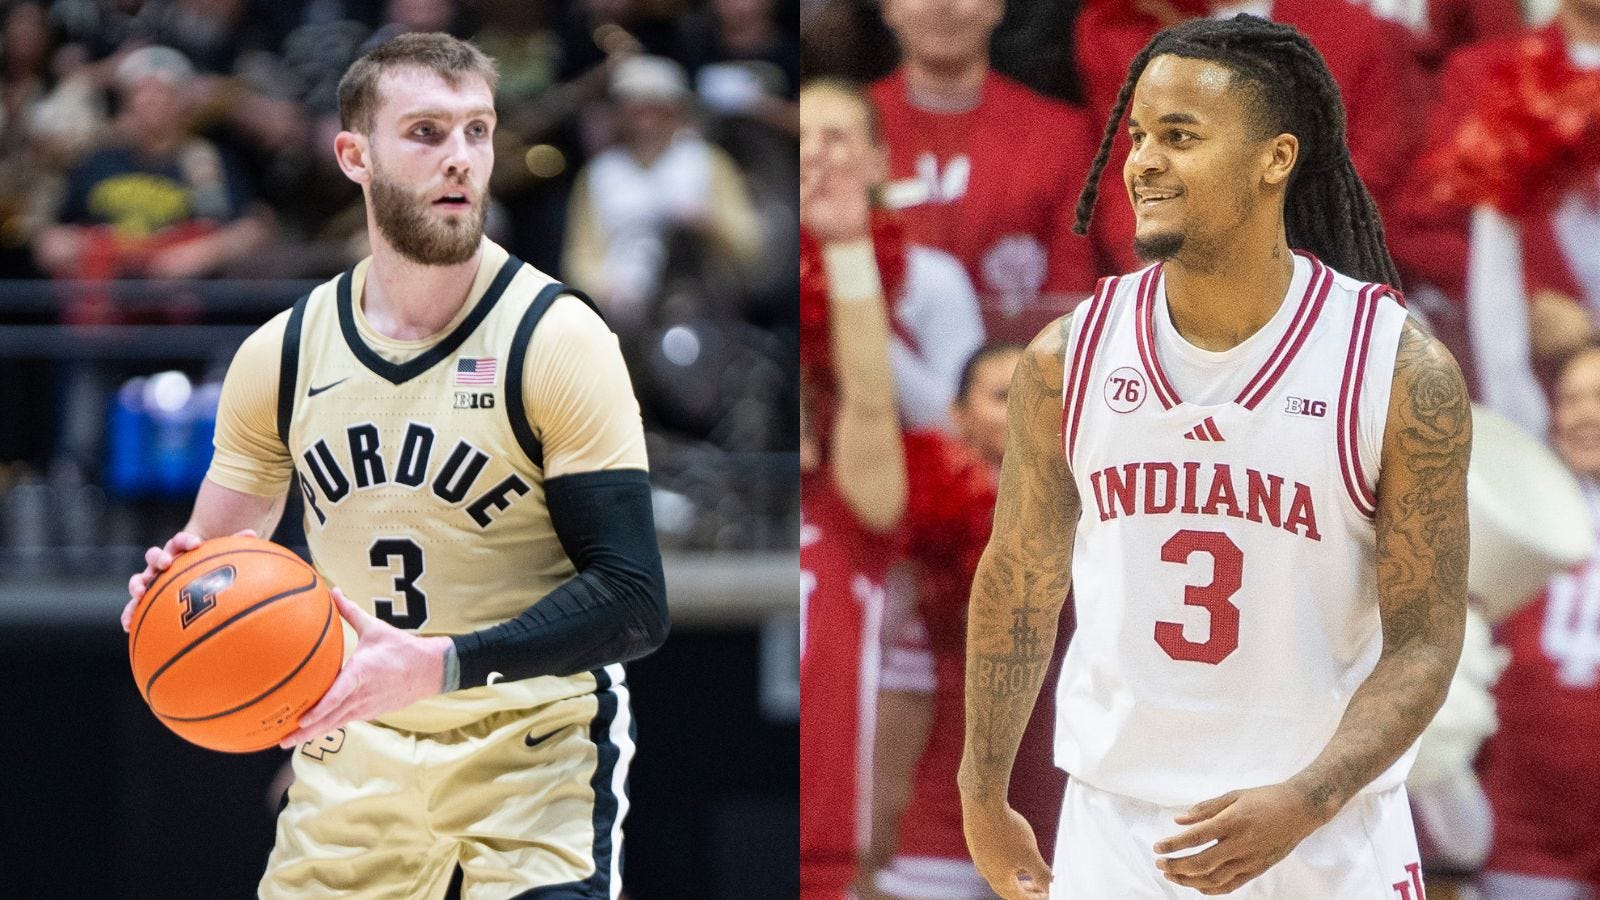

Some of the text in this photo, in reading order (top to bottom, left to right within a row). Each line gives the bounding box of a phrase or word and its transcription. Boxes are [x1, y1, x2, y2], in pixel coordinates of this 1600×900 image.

[299, 420, 532, 529] PURDUE
[1090, 461, 1322, 542] INDIANA
[179, 564, 237, 630] P
[368, 537, 430, 632] 3
[1153, 529, 1245, 665] 3
